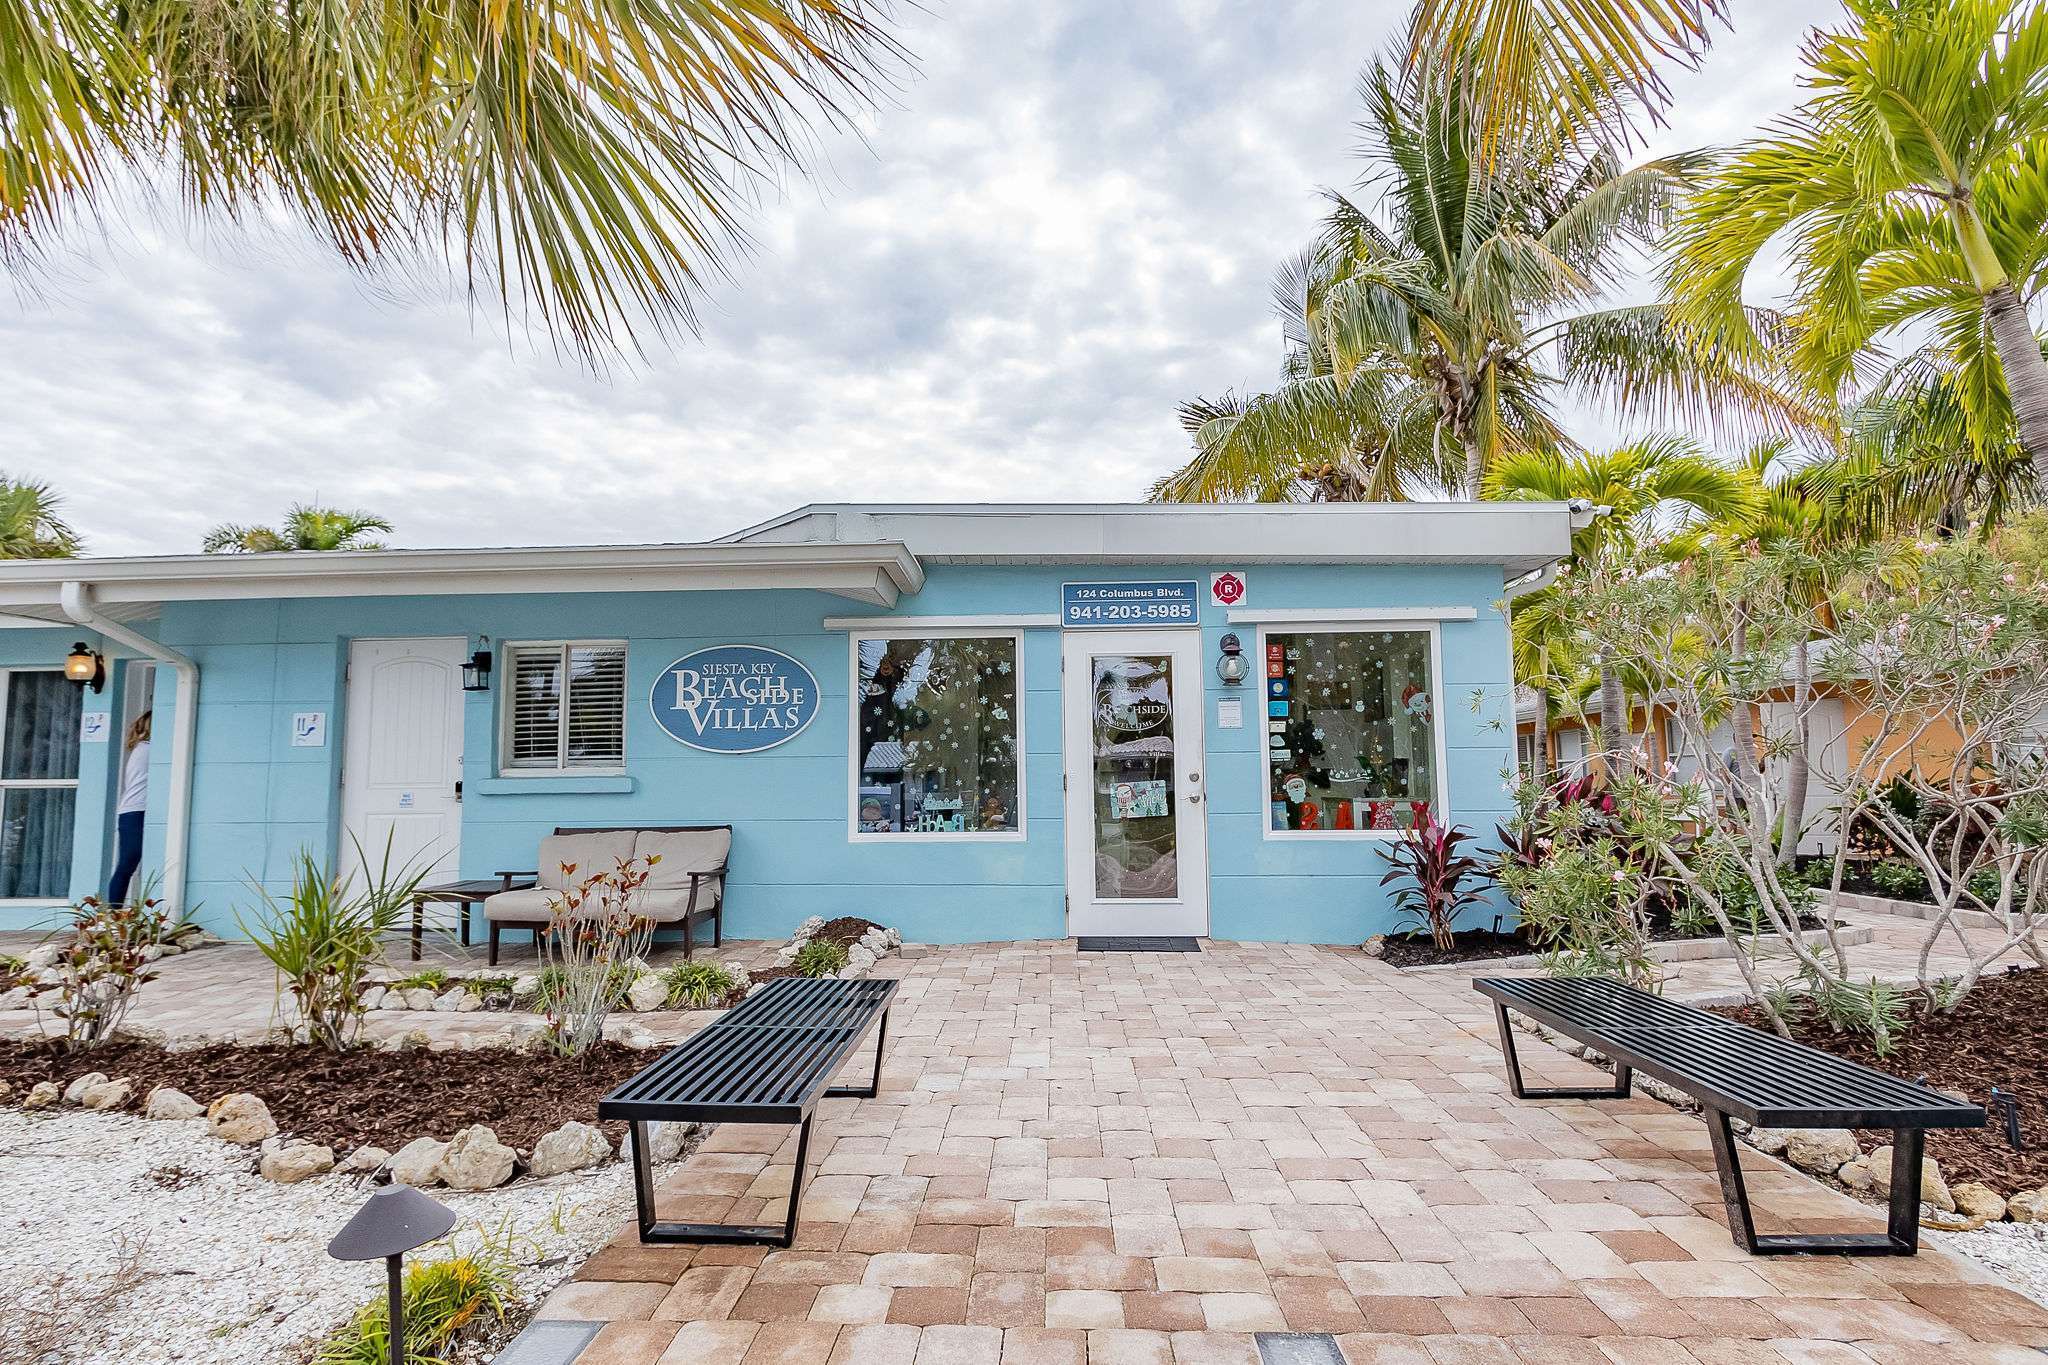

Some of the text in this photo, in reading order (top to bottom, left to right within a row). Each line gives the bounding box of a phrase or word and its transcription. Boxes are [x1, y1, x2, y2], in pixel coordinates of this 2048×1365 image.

[1077, 588, 1184, 598] 124 Columbus Blvd.
[1225, 585, 1233, 594] R
[1070, 604, 1191, 619] 941-203-5985
[703, 663, 776, 675] SIESTA KEY
[670, 669, 787, 710] BEACH
[747, 688, 804, 705] SIDE
[1101, 703, 1166, 716] BCHSIDE
[683, 700, 799, 737] VILLAS
